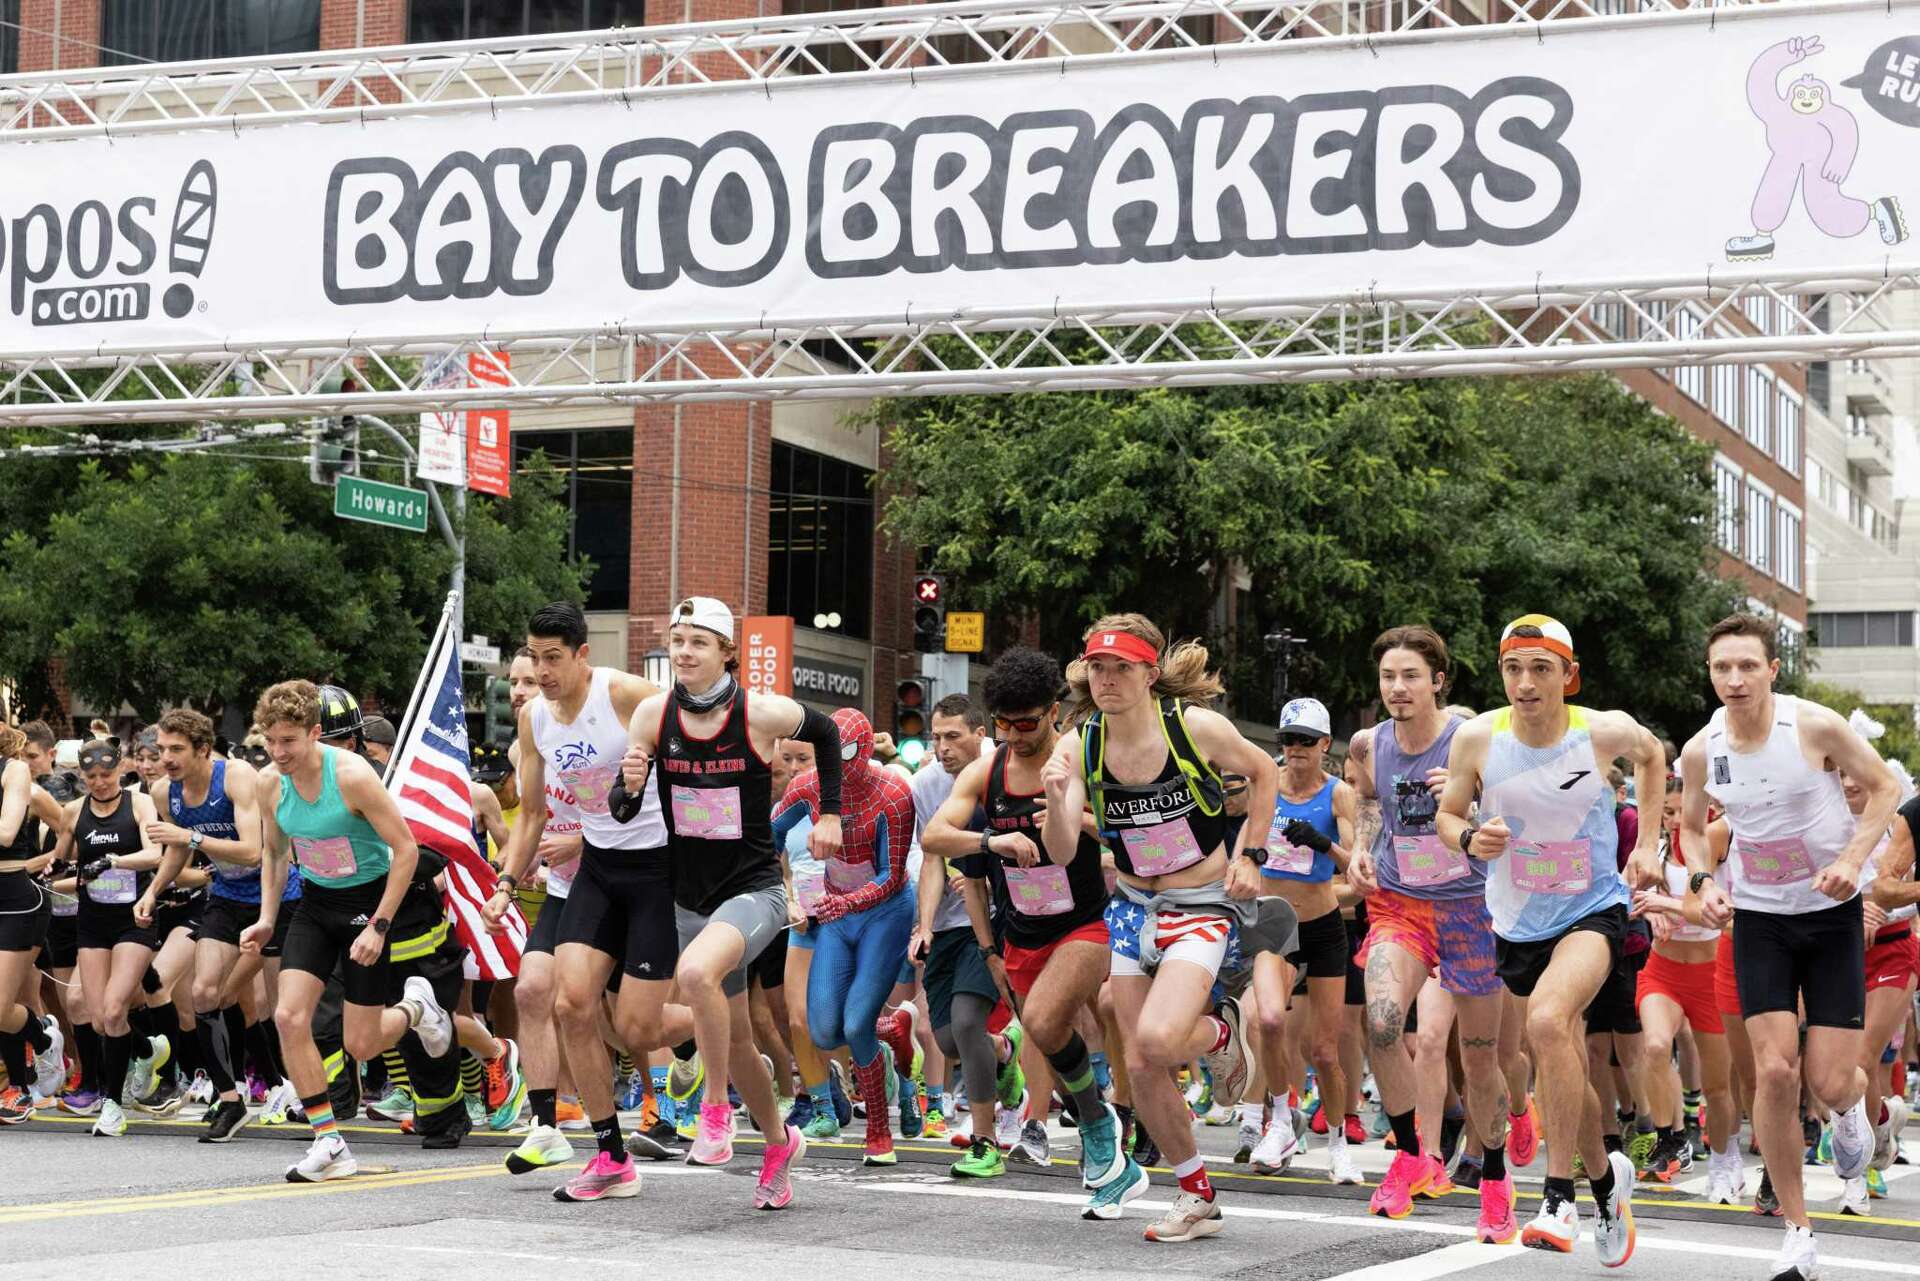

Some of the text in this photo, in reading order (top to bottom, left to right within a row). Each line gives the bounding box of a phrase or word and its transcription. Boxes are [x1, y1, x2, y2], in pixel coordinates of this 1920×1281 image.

[1886, 50, 1920, 78] LE
[1879, 75, 1920, 107] RU
[323, 76, 1581, 305] BAY TO BREAKERS
[352, 487, 414, 519] Howard
[748, 632, 763, 694] ROPER
[792, 665, 859, 696] OPER FOOD
[1104, 788, 1193, 816] AVERFOR
